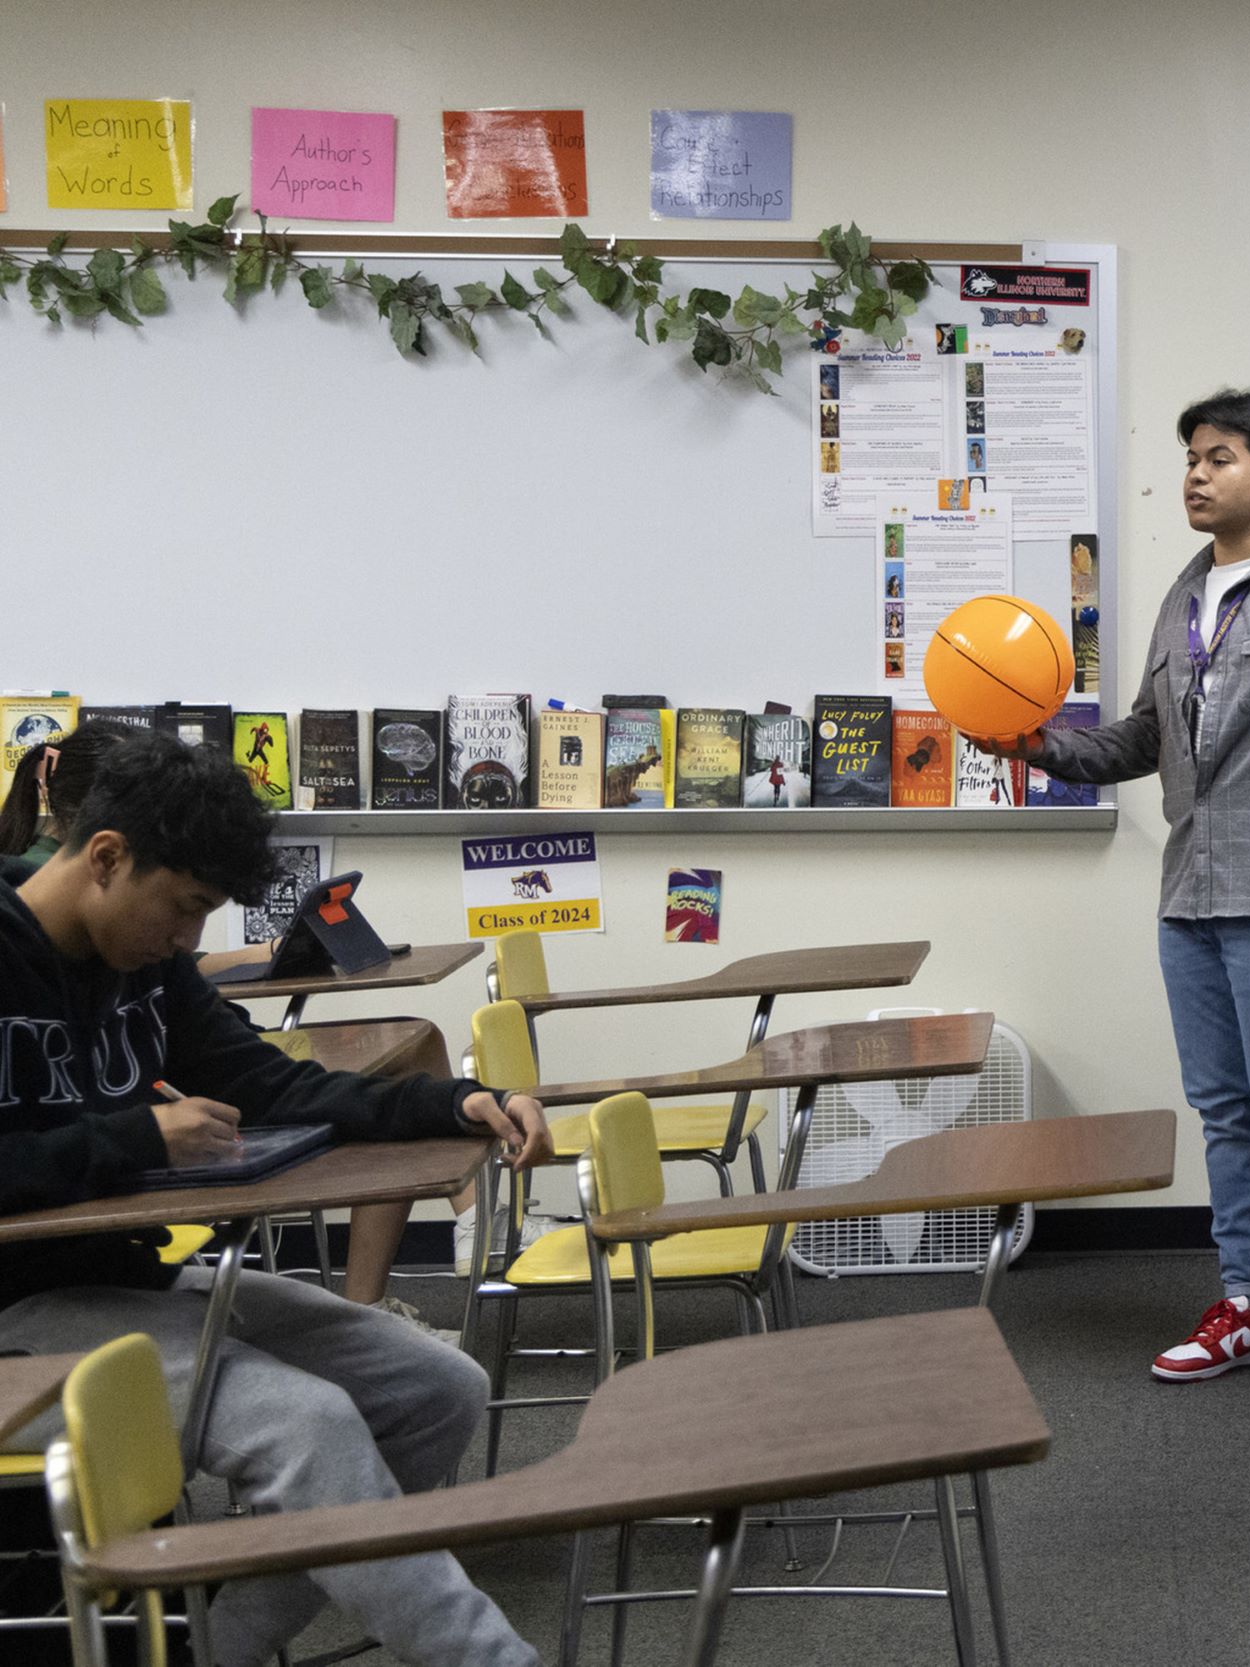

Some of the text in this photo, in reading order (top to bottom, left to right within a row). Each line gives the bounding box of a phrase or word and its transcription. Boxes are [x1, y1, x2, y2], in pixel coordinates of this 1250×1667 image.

[49, 104, 177, 152] Meaning
[108, 144, 121, 159] of
[290, 133, 373, 167] Author's
[57, 165, 154, 197] Words
[270, 165, 364, 204] Approach
[660, 180, 784, 216] Relationships
[1016, 275, 1066, 287] NORTHERN
[996, 284, 1035, 296] ILLINOIS
[455, 709, 518, 721] CHILDREN
[543, 714, 580, 723] ERNEST
[681, 713, 742, 723] ORDINARY
[821, 709, 885, 724] LUCY FOLEY
[542, 723, 579, 732] GAINES
[691, 725, 729, 736] GRACE
[895, 716, 950, 731] HOMEGOING
[464, 726, 512, 740] BLOOD
[841, 727, 866, 740] THE
[320, 744, 356, 753] SEPETYS
[468, 746, 506, 760] BONE
[822, 740, 882, 759] GUEST
[541, 759, 550, 769] A
[836, 757, 870, 775] LIST
[966, 759, 992, 776] Other
[302, 776, 325, 787] SALT
[332, 776, 356, 787] SEA
[541, 769, 579, 780] Lesson
[541, 781, 577, 792] Before
[958, 776, 991, 791] Filters
[541, 791, 573, 804] Dying
[467, 837, 592, 863] WELCOME
[513, 882, 540, 900] RM
[478, 907, 591, 929] Class of 2024
